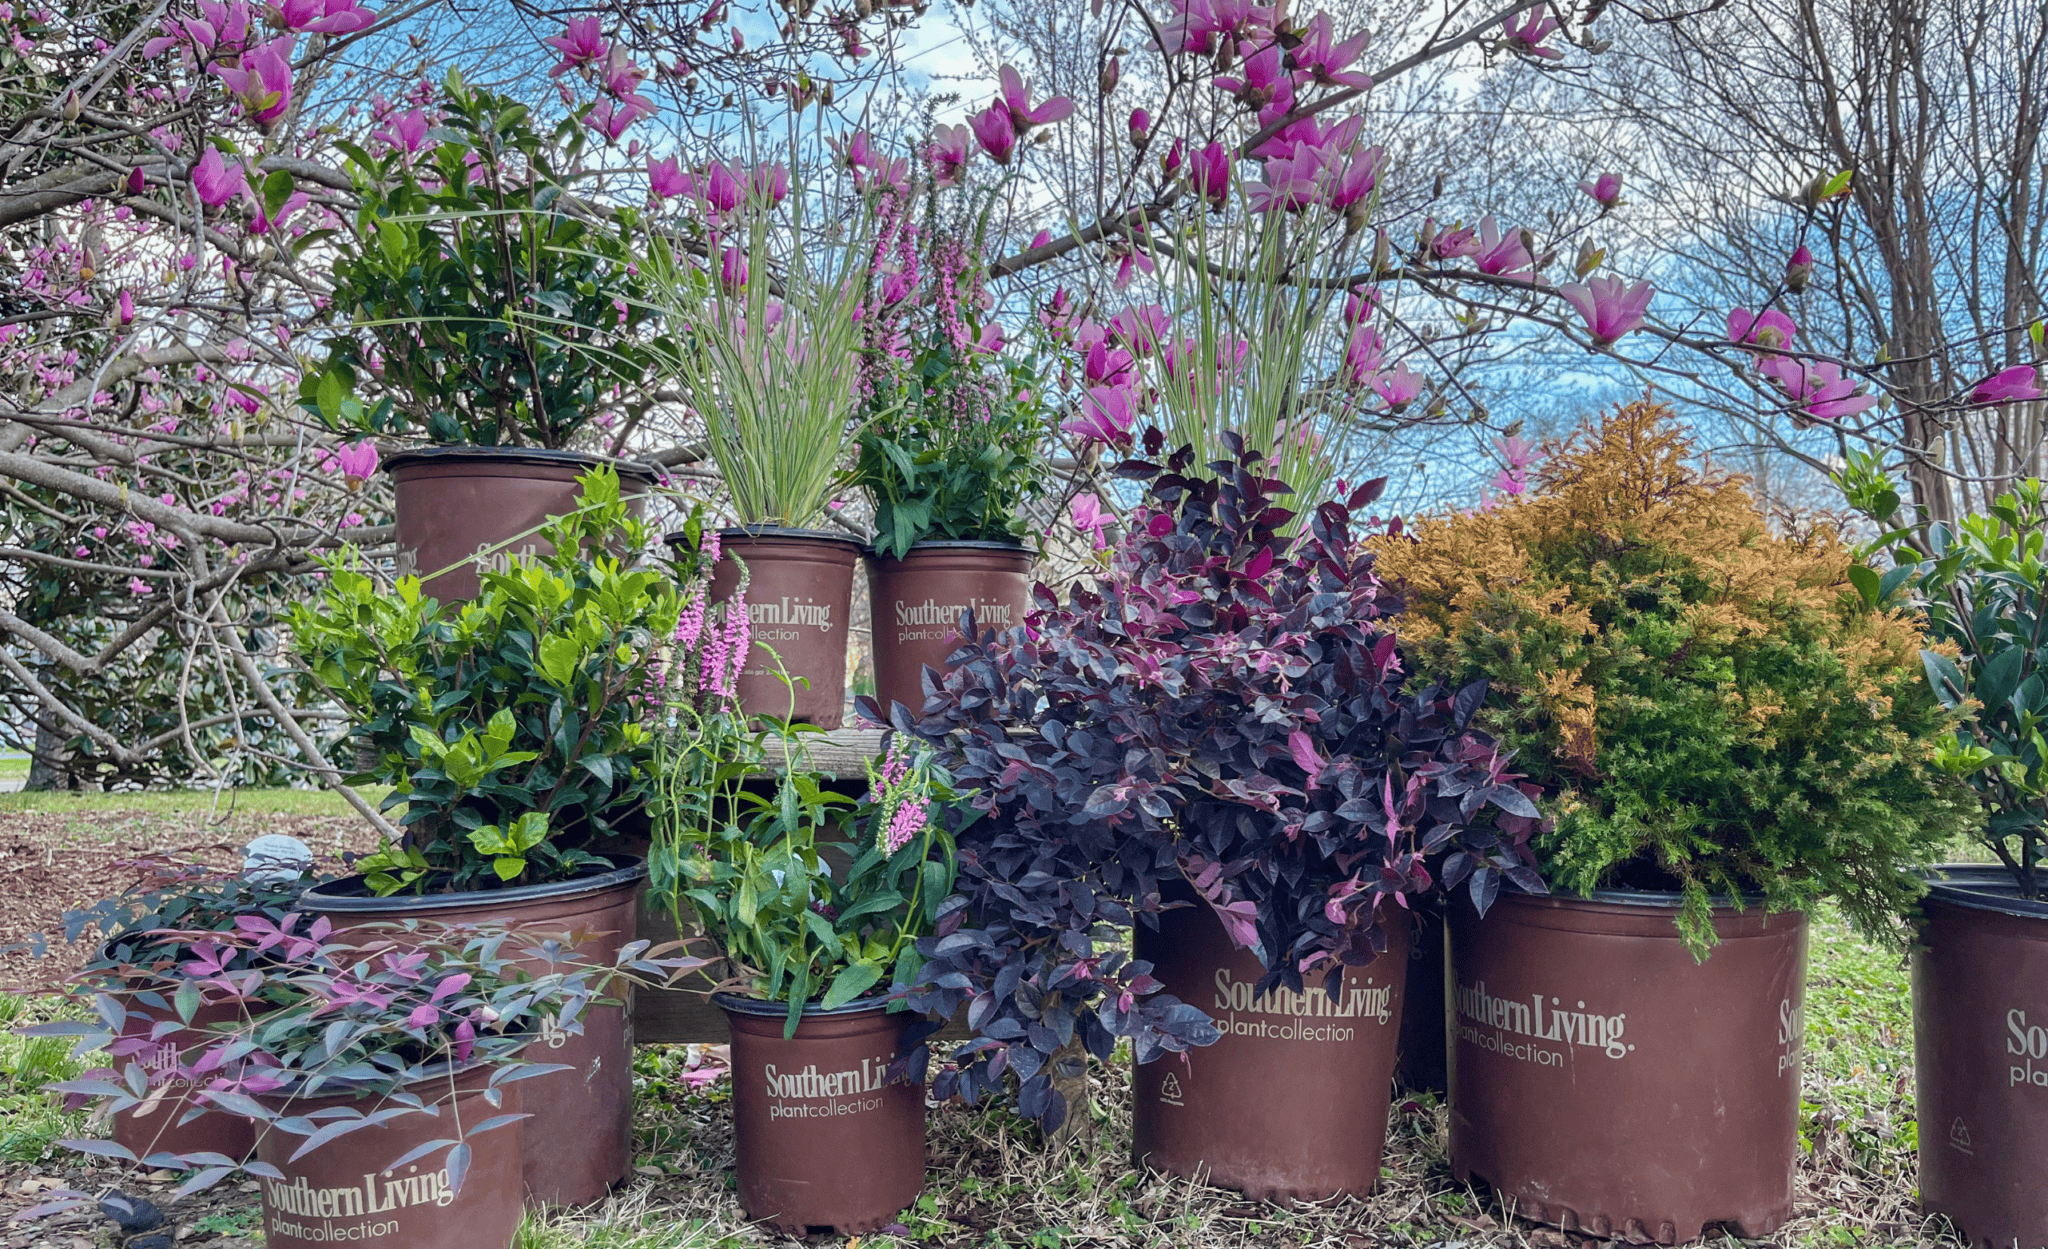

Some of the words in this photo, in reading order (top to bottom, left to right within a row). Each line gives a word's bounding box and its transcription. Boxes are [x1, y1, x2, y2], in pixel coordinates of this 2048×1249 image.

[1217, 1012, 1354, 1041] plantcollection
[1532, 993, 1636, 1060] Living.
[765, 1063, 861, 1099] Southern
[770, 1098, 884, 1122] plantcollection
[268, 1175, 364, 1219] Southern
[363, 1164, 456, 1208] Living
[271, 1211, 399, 1242] plantcollection
